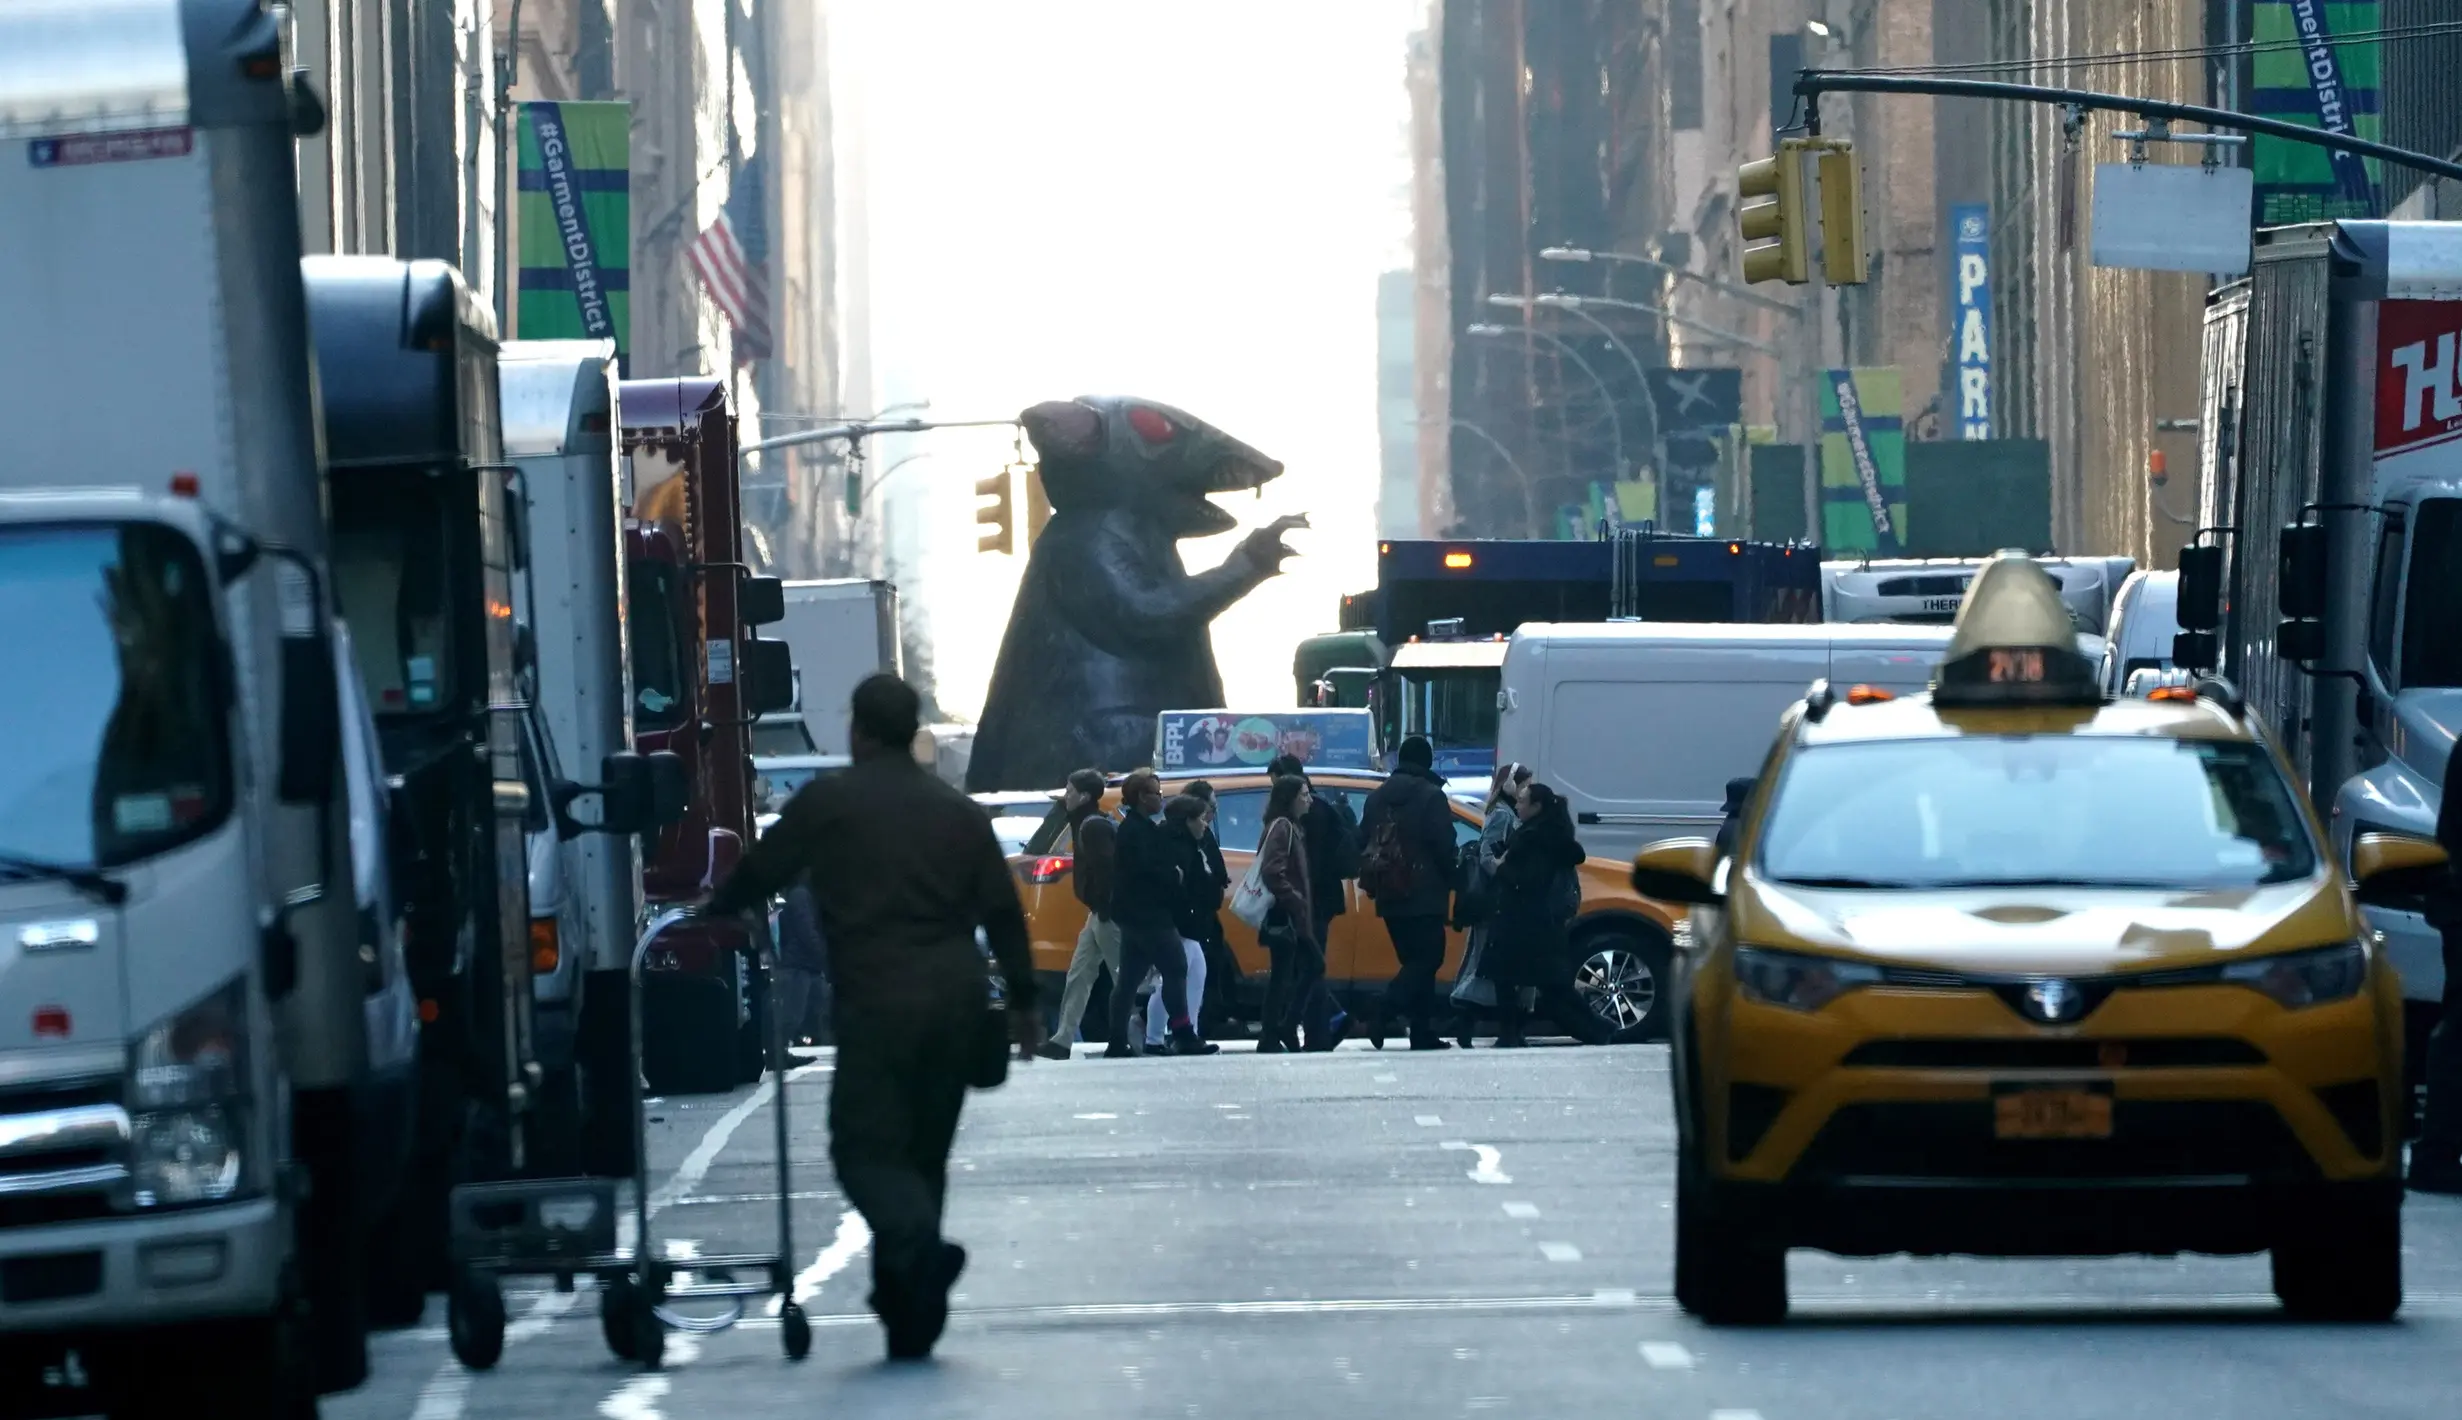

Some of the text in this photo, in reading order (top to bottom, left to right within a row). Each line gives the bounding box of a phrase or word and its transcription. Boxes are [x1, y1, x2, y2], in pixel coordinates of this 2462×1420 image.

[2297, 0, 2350, 162] mentDistrit
[540, 122, 606, 332] #GarmentDistrict
[1922, 599, 1960, 610] THER
[1166, 717, 1185, 765] BFPL
